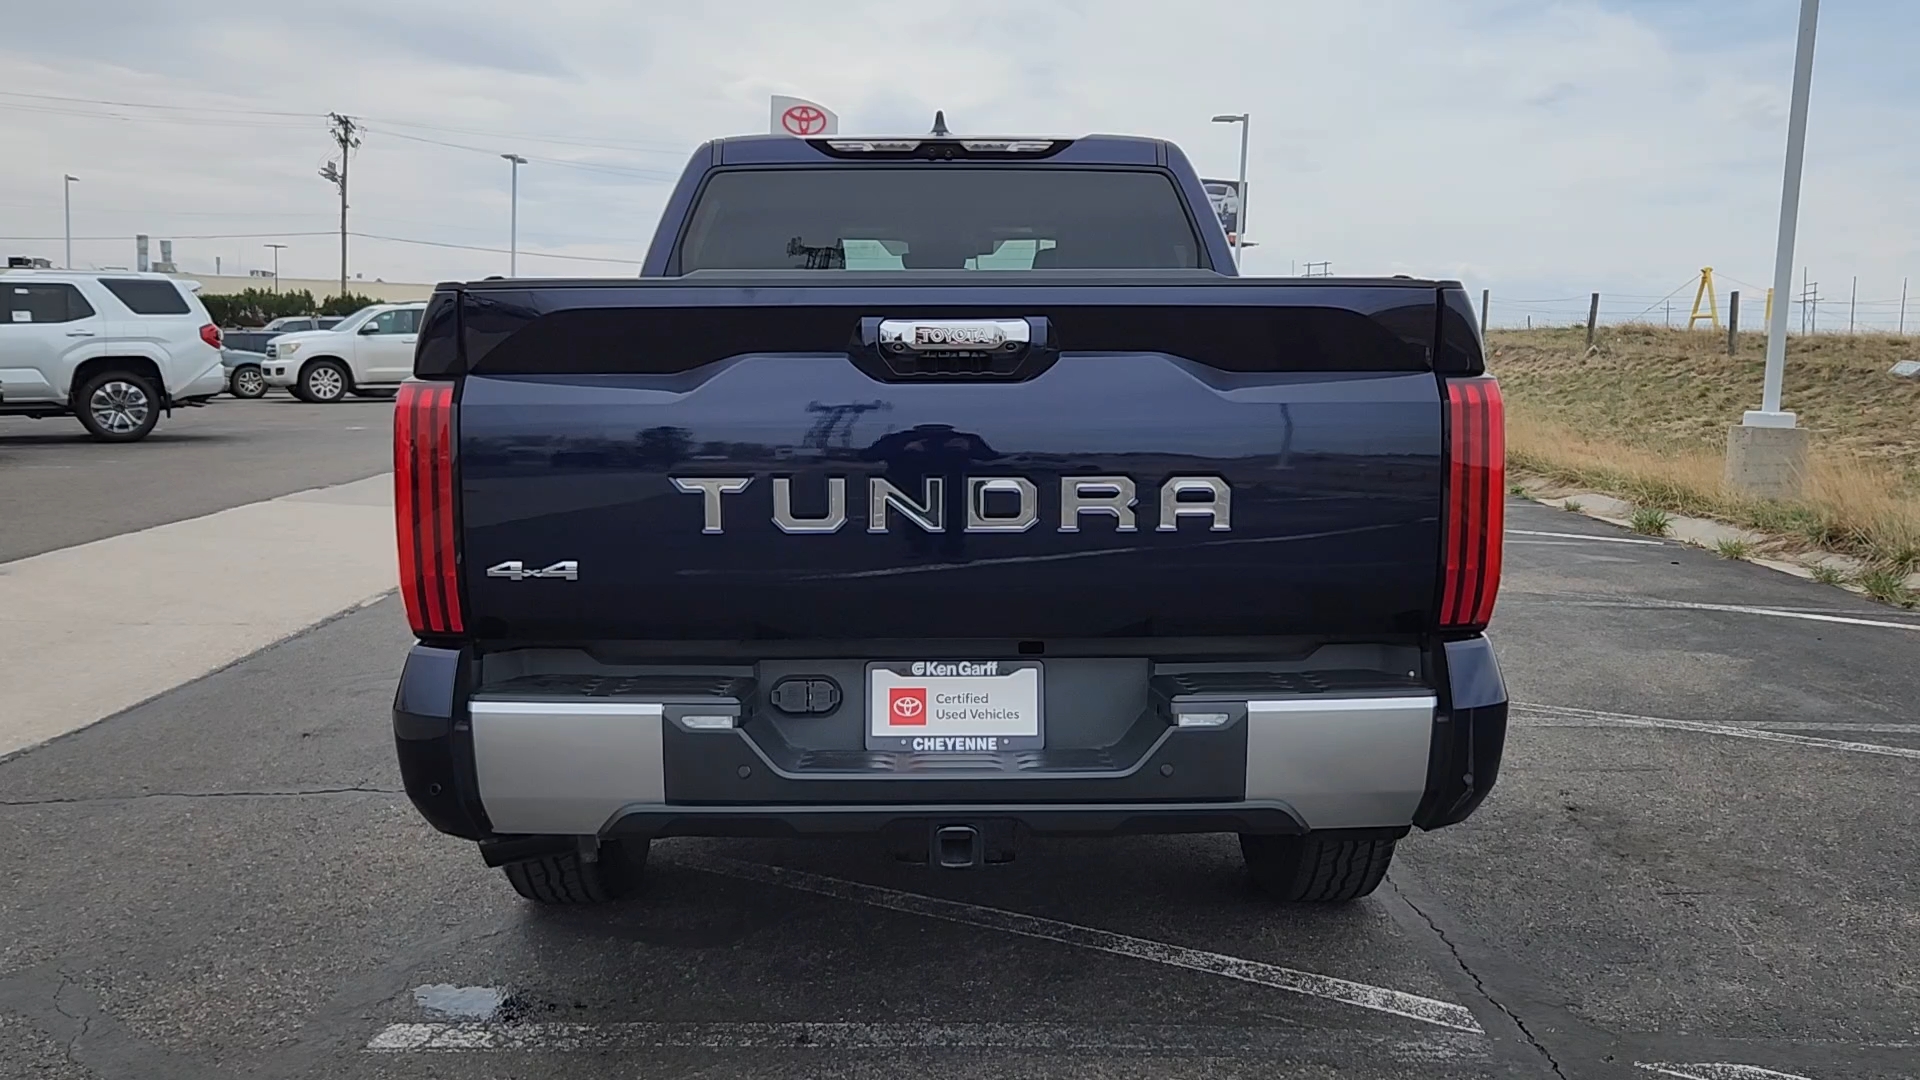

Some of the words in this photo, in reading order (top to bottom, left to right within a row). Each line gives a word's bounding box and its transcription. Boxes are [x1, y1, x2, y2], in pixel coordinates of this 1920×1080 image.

[920, 328, 989, 343] TOYOTA
[668, 476, 1233, 534] TUNDRA
[487, 561, 578, 580] 4x4
[926, 661, 957, 676] Ken
[959, 661, 998, 676] Garff
[936, 693, 989, 704] Certified
[936, 708, 967, 720] Used
[970, 708, 1020, 720] Vehicles
[912, 738, 997, 750] CHEYENNE
